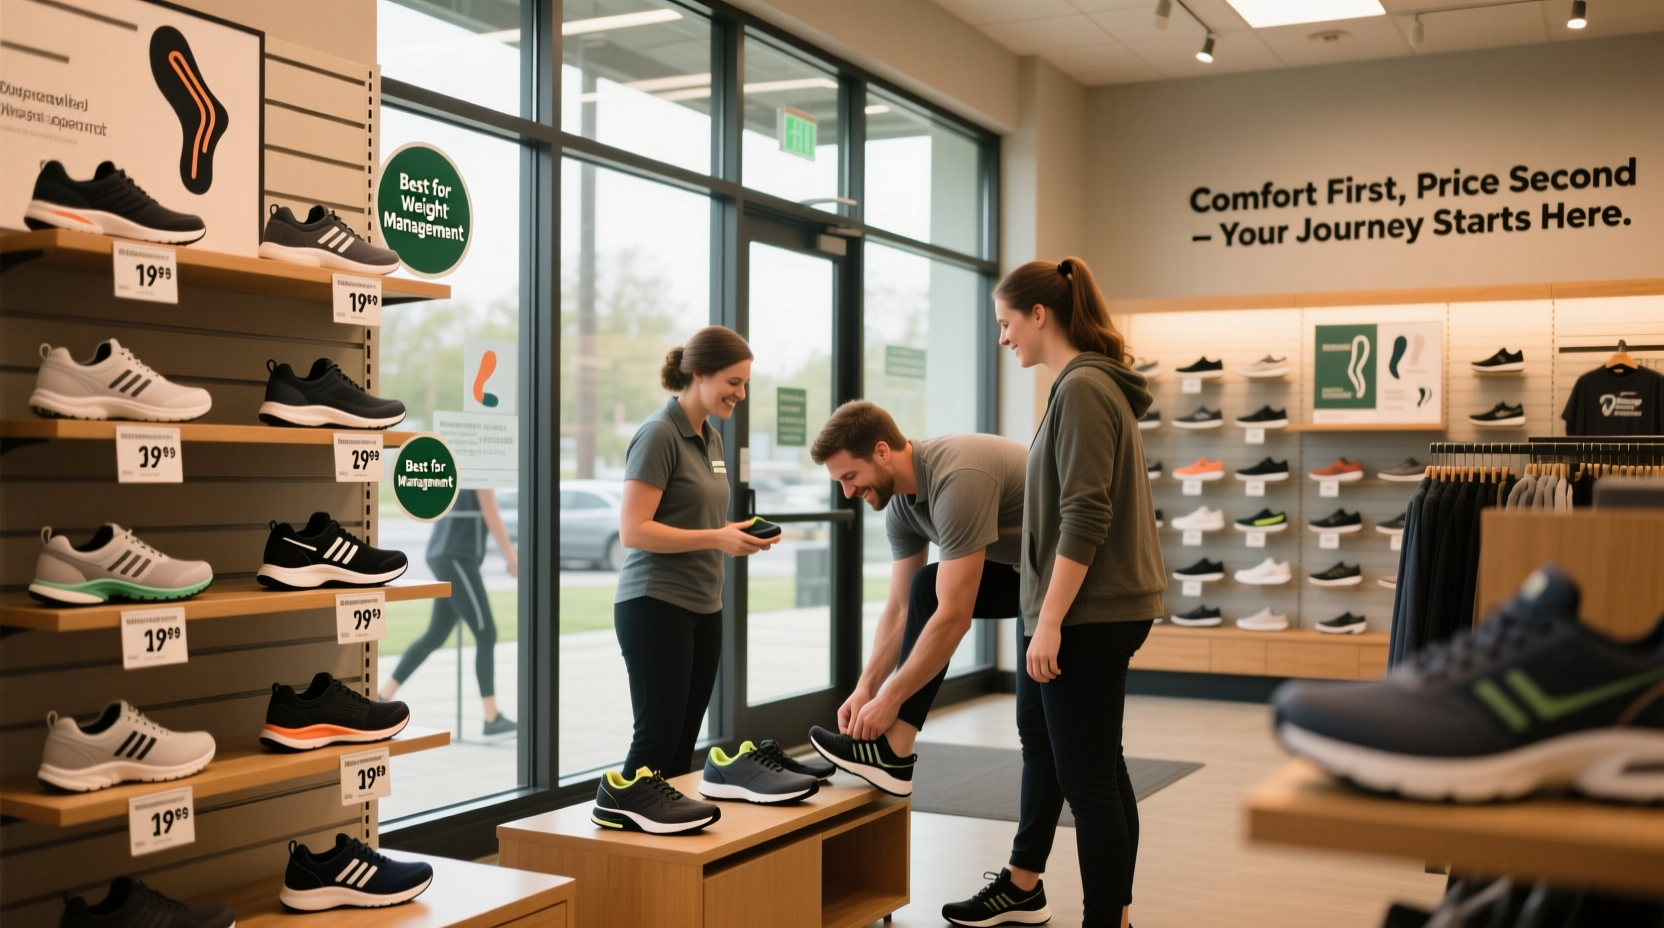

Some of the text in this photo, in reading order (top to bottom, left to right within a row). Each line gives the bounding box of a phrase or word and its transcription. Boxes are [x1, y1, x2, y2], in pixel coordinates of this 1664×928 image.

[399, 172, 452, 199] Best for
[1189, 156, 1637, 214] Comfort First, Price Second
[401, 194, 450, 222] Weight
[383, 210, 465, 242] Management
[1219, 220, 1289, 247] Your
[1296, 215, 1424, 245] Journey
[1433, 206, 1532, 236] Starts
[1541, 202, 1633, 230] Here.
[144, 626, 181, 653] 1999
